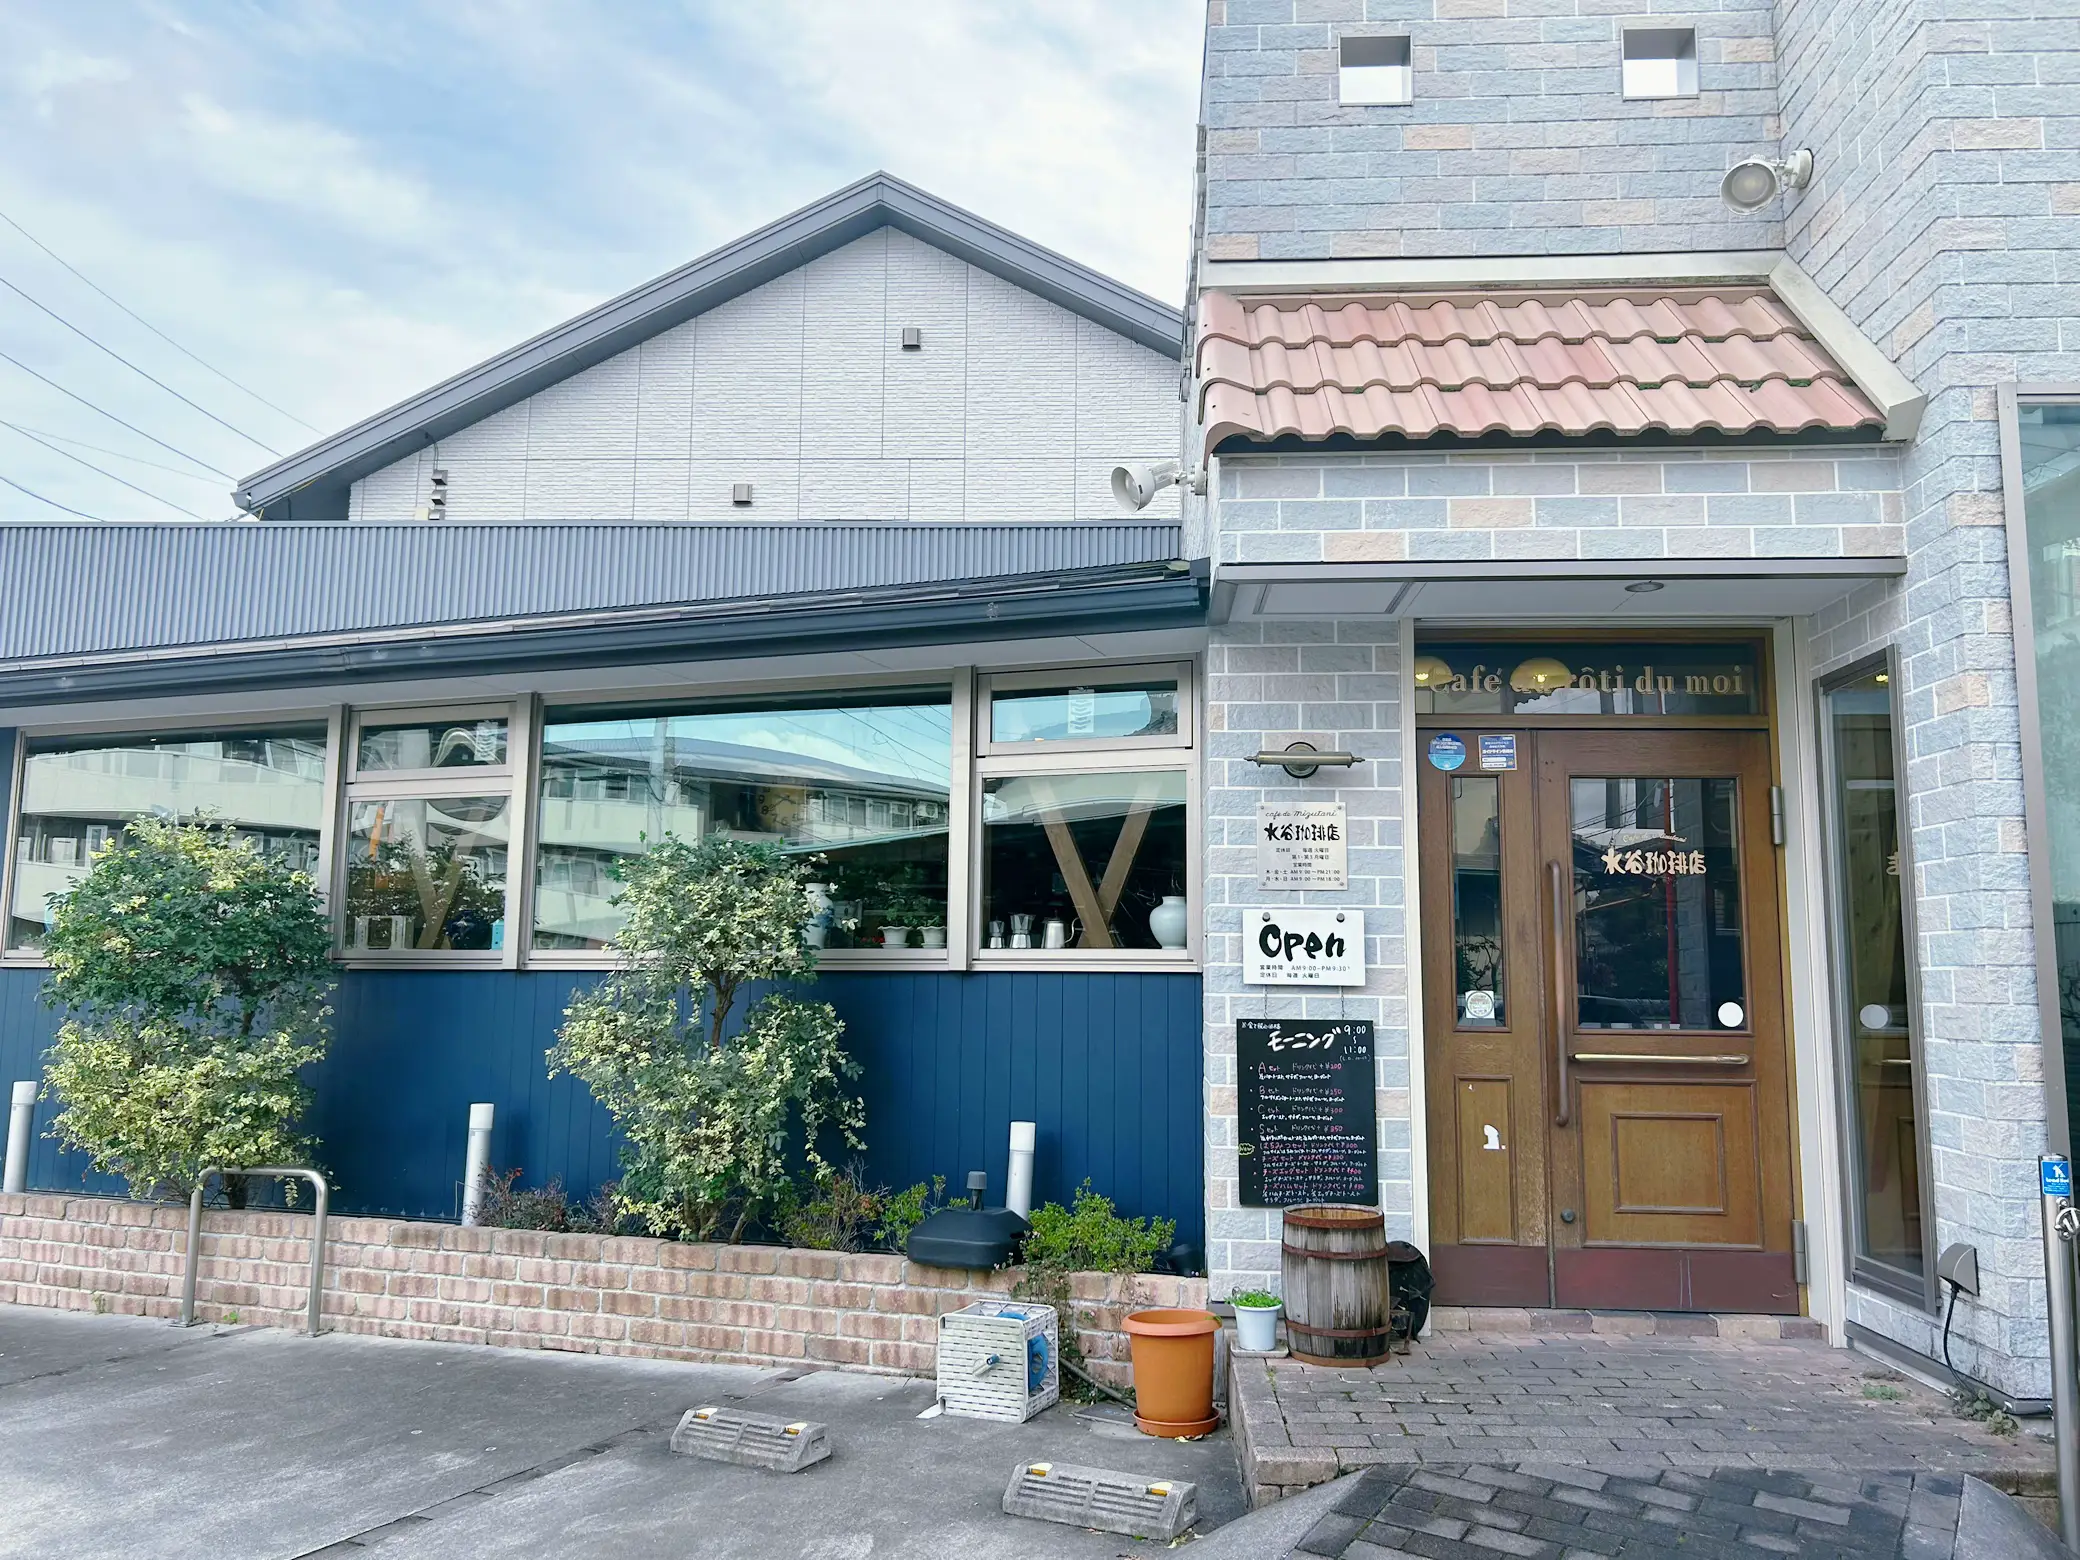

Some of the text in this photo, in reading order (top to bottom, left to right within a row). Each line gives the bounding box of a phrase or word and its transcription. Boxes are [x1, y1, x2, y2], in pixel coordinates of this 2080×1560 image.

[1635, 665, 1676, 694] du
[1685, 665, 1745, 694] moi
[1264, 822, 1340, 841] 水谷珈琲店
[1601, 847, 1707, 875] 水谷珈琲店
[1259, 924, 1347, 962] Open
[1267, 1027, 1342, 1052] モーニング
[1343, 1024, 1367, 1035] 9:00
[1343, 1046, 1367, 1054] 11:00
